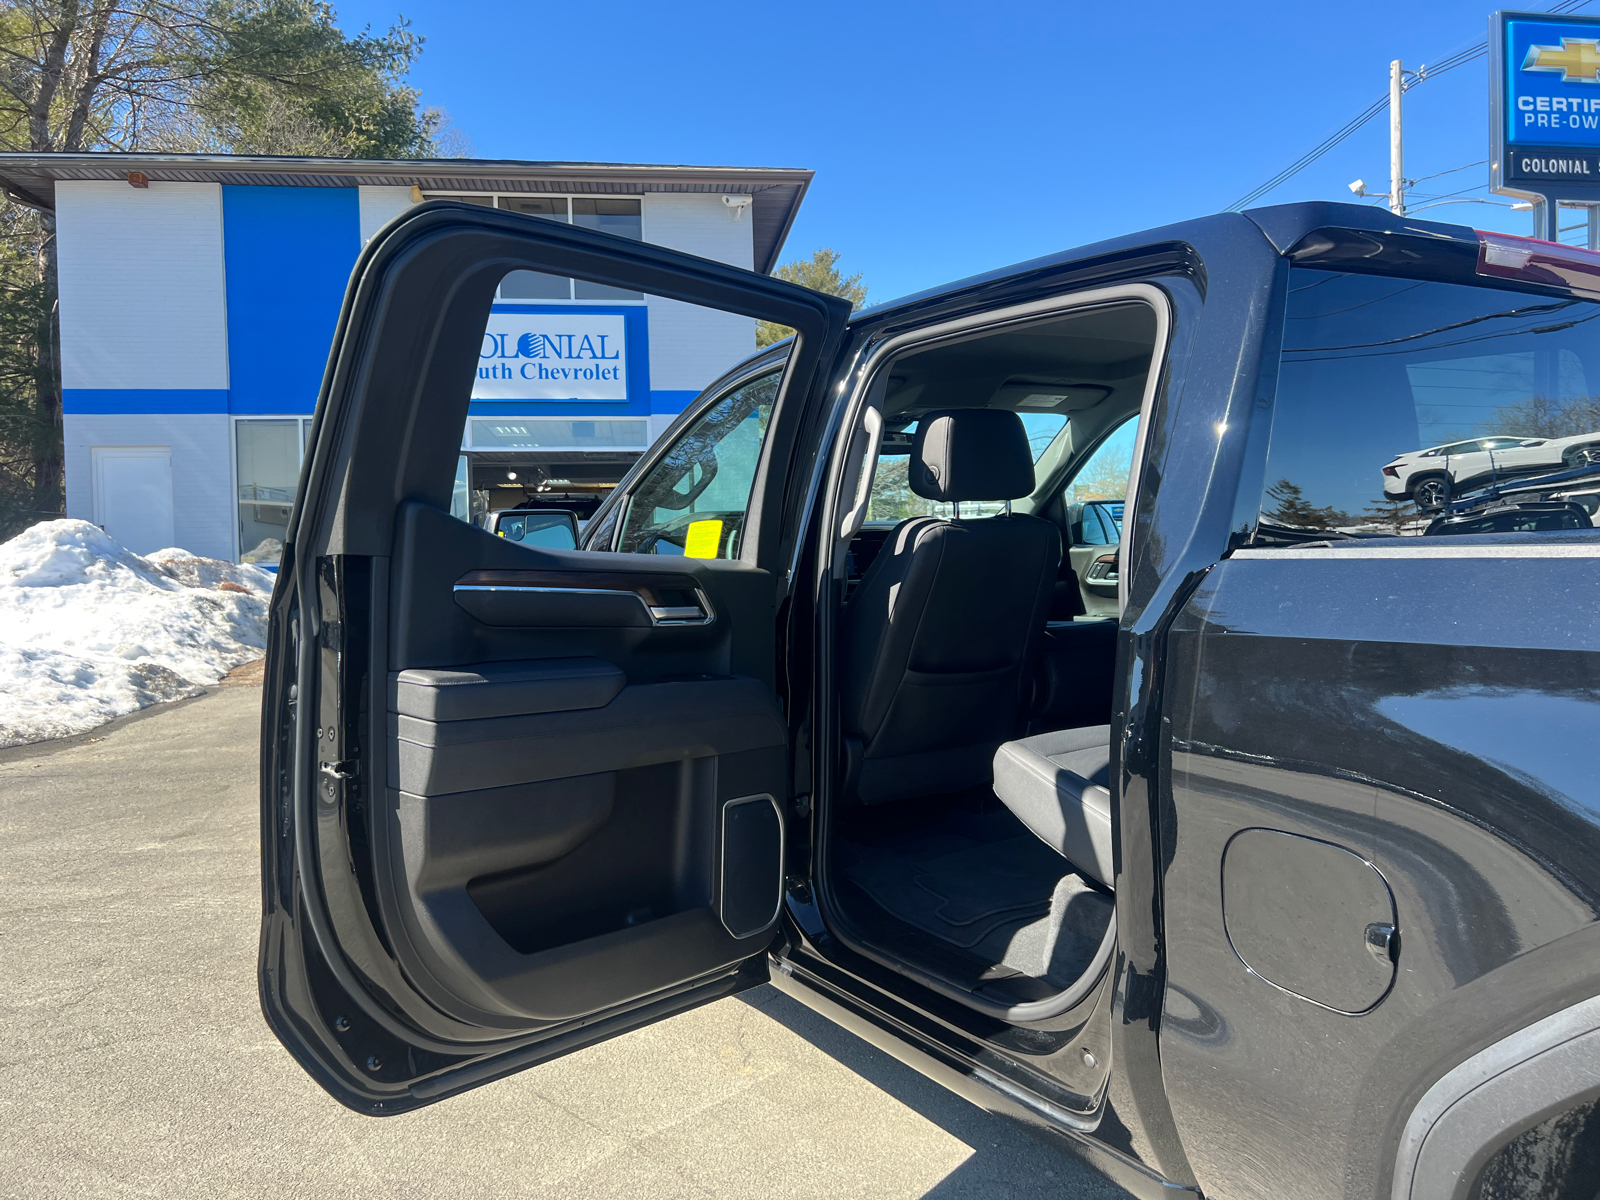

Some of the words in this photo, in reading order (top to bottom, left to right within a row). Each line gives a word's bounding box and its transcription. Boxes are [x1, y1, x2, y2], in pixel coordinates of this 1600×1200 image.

[1518, 95, 1600, 113] CERTIF
[1524, 113, 1599, 129] PRE-OW
[1521, 158, 1590, 174] COLONIAL
[475, 362, 513, 380] uth
[520, 362, 620, 381] Chevrolet
